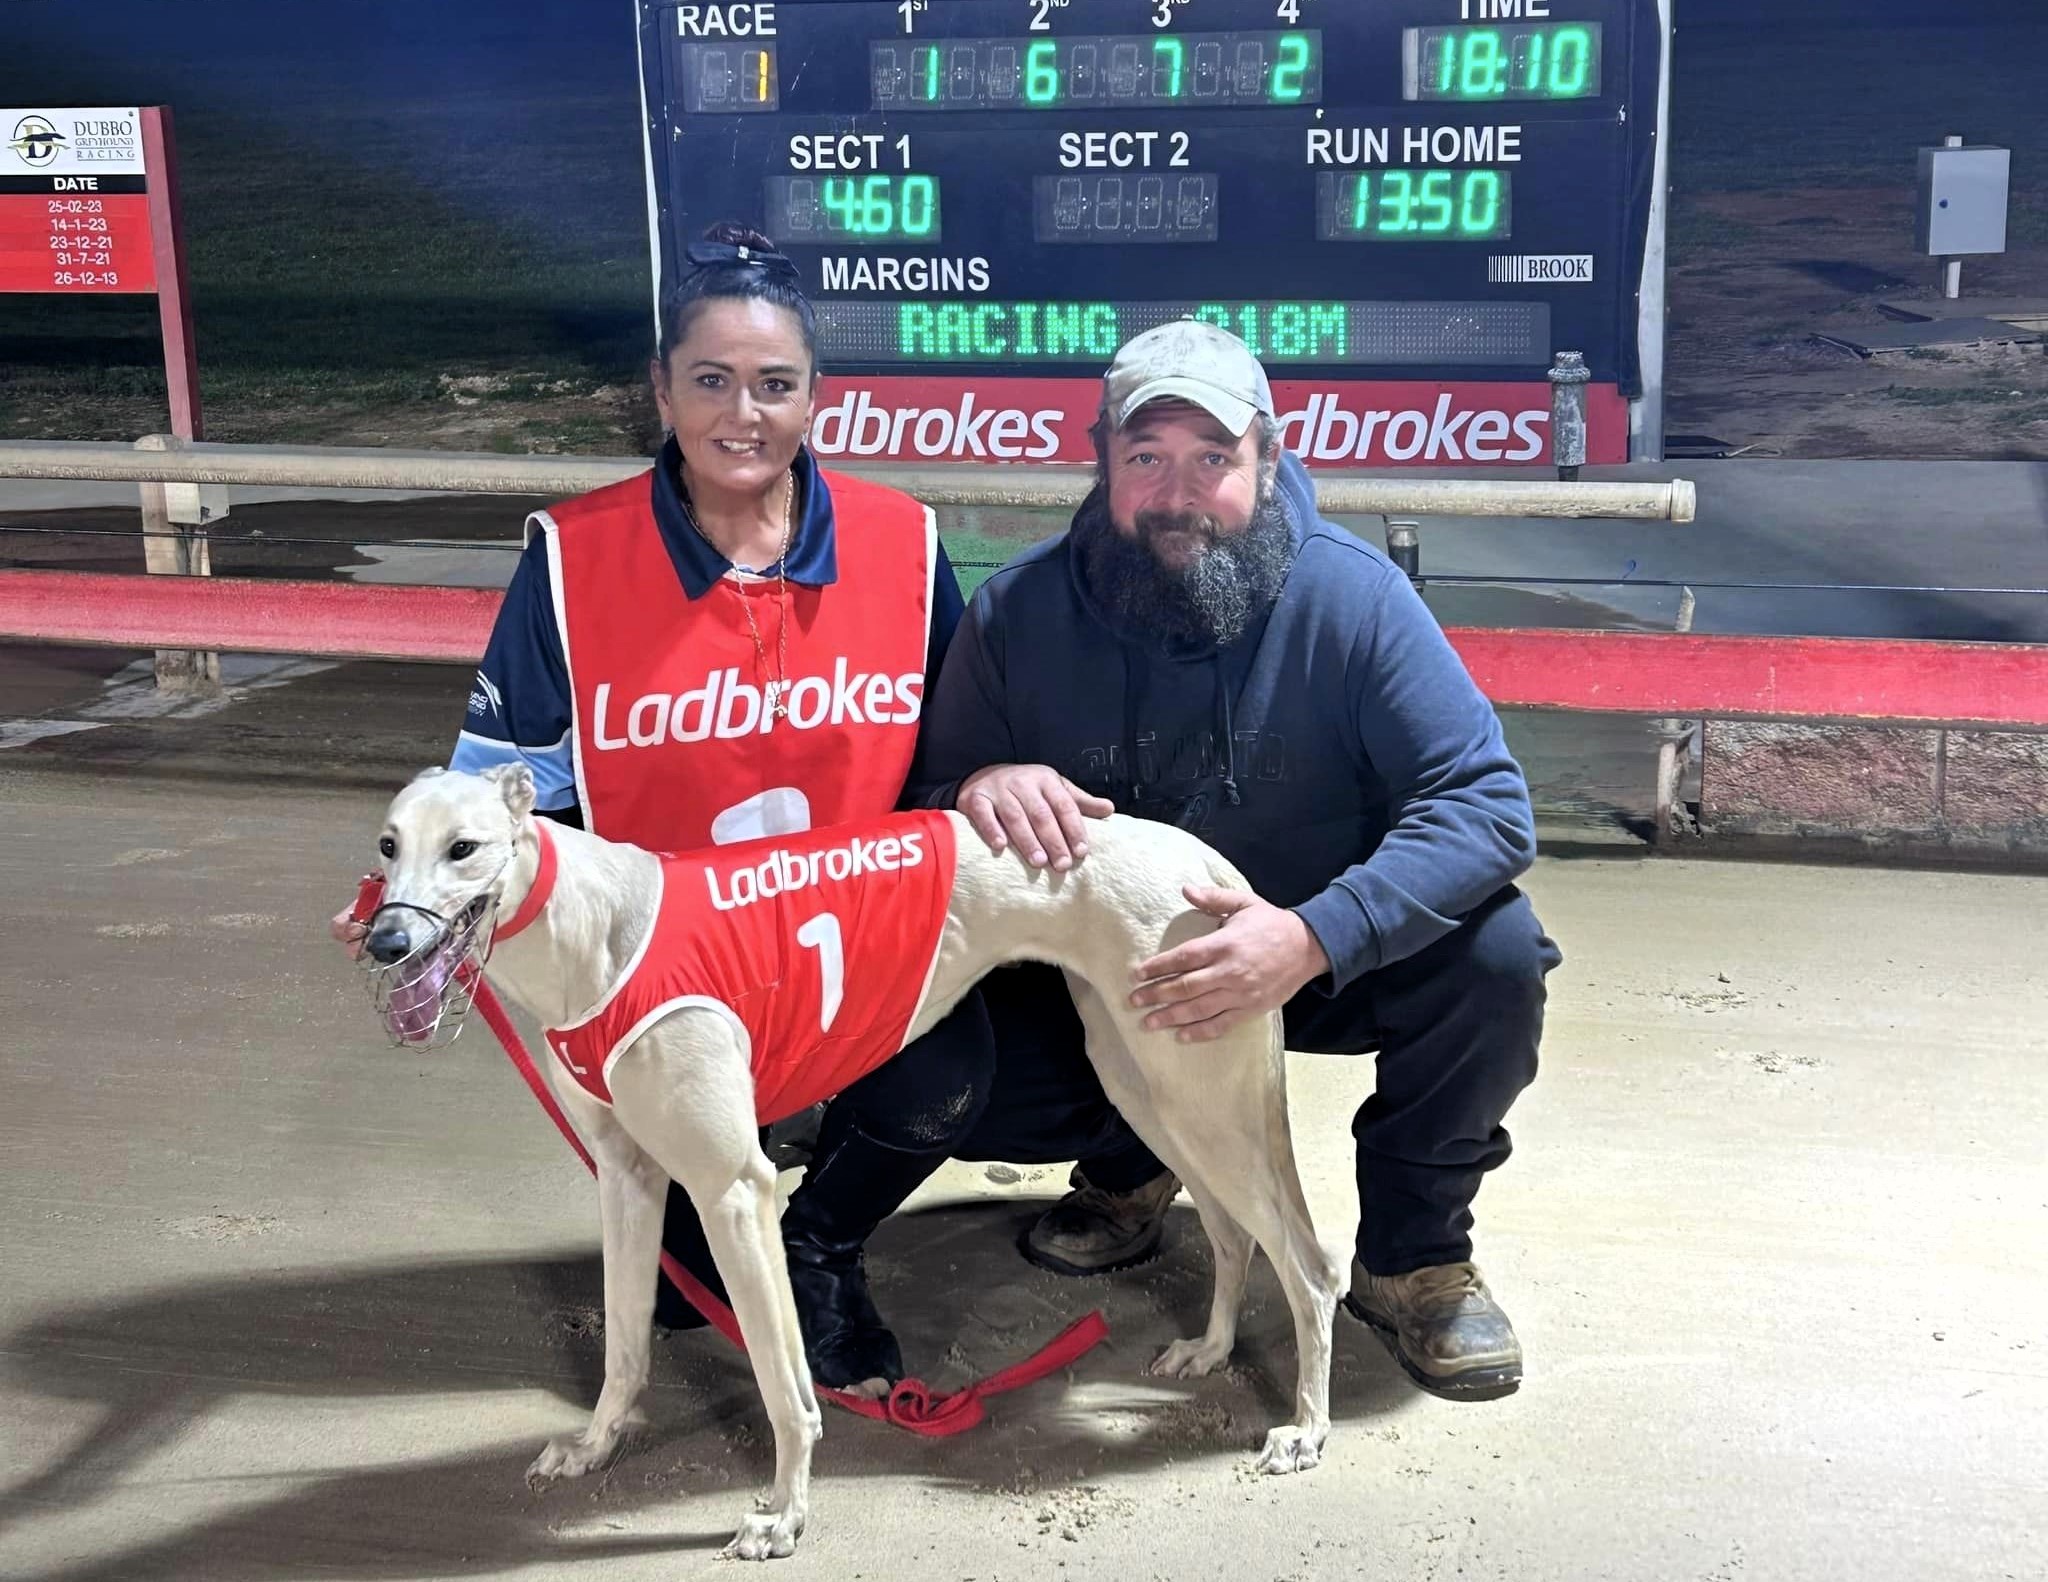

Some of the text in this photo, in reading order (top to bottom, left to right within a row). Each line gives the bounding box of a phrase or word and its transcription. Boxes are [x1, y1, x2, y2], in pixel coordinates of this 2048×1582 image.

[678, 4, 776, 36] RACE
[759, 51, 768, 102] 1
[927, 36, 1308, 101] 1 6 7 2
[73, 121, 133, 136] DUBBO
[75, 137, 134, 146] GREYHOUND
[1307, 126, 1522, 164] RUN HOME
[76, 150, 135, 158] RACING
[790, 135, 910, 169] SECT 1
[1059, 131, 1189, 167] SECT 2
[54, 177, 98, 191] DATE
[48, 200, 102, 213] 25-02-23
[51, 218, 107, 231] 14-1-23
[50, 236, 112, 249] 23-12-21
[56, 253, 110, 265] 31-7-21
[54, 272, 118, 285] 26-12-13
[822, 257, 990, 291] MARGINS
[1528, 258, 1588, 279] BROOK
[900, 303, 1117, 354] RACING
[812, 390, 1064, 458] dbrokes
[1279, 393, 1550, 461] dbrokes
[594, 656, 924, 751] Ladbrokes
[704, 832, 923, 911] Ladbrokes
[796, 912, 845, 1033] 1
